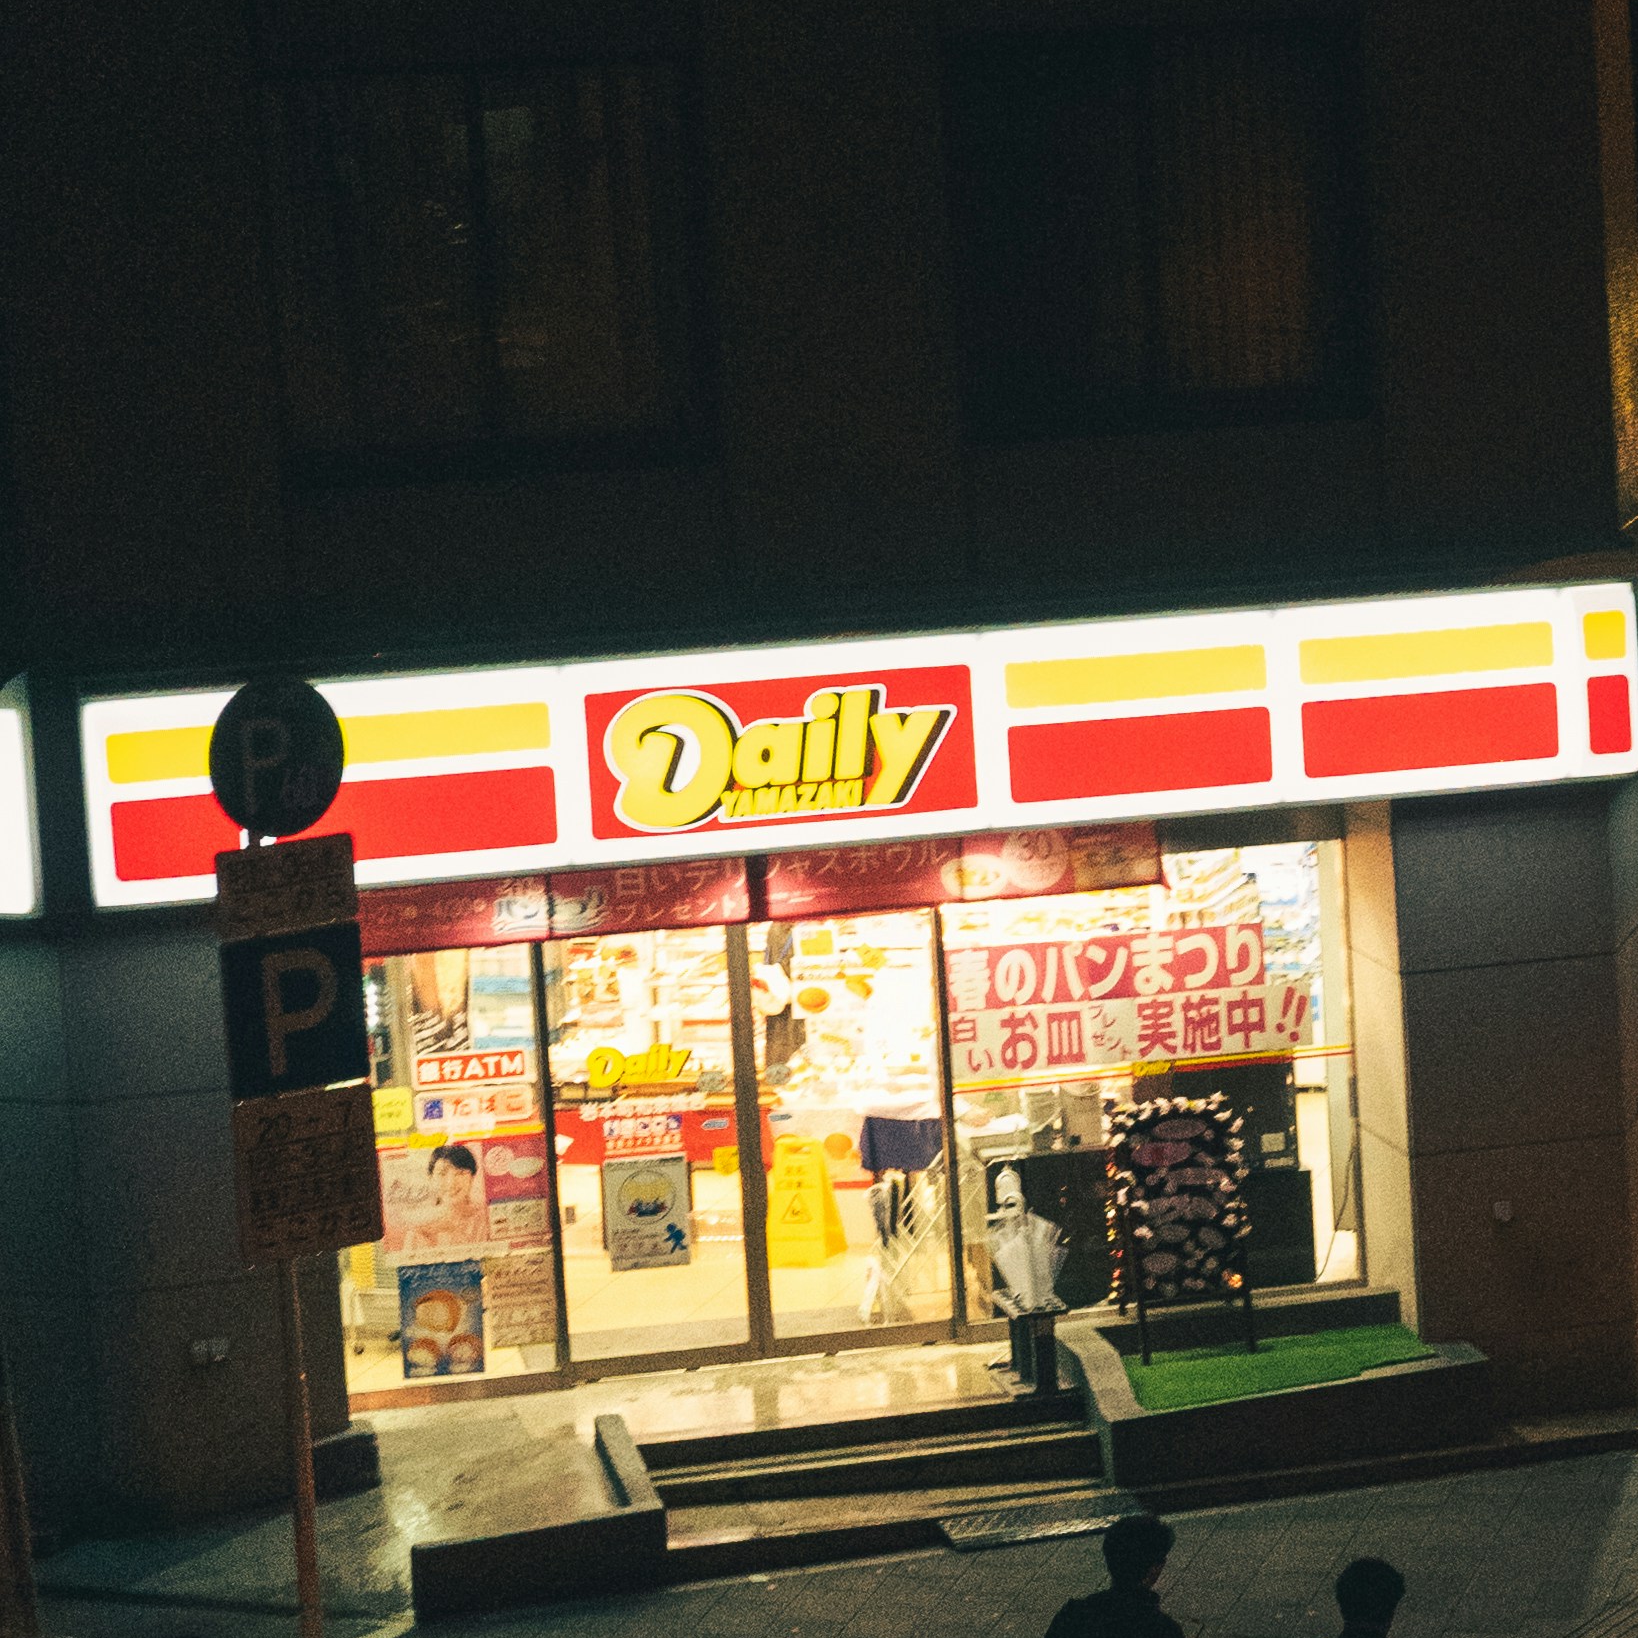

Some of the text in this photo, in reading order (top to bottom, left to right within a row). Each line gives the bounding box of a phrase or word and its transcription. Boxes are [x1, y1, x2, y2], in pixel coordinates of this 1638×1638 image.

[241, 717, 290, 816] P
[609, 688, 952, 828] Daily
[721, 779, 864, 818] YAMAZAKI
[261, 947, 338, 1076] P
[948, 927, 1263, 1012] 春のパンまつり
[418, 1052, 524, 1083] 銀行ATM
[587, 1044, 692, 1089] Daily
